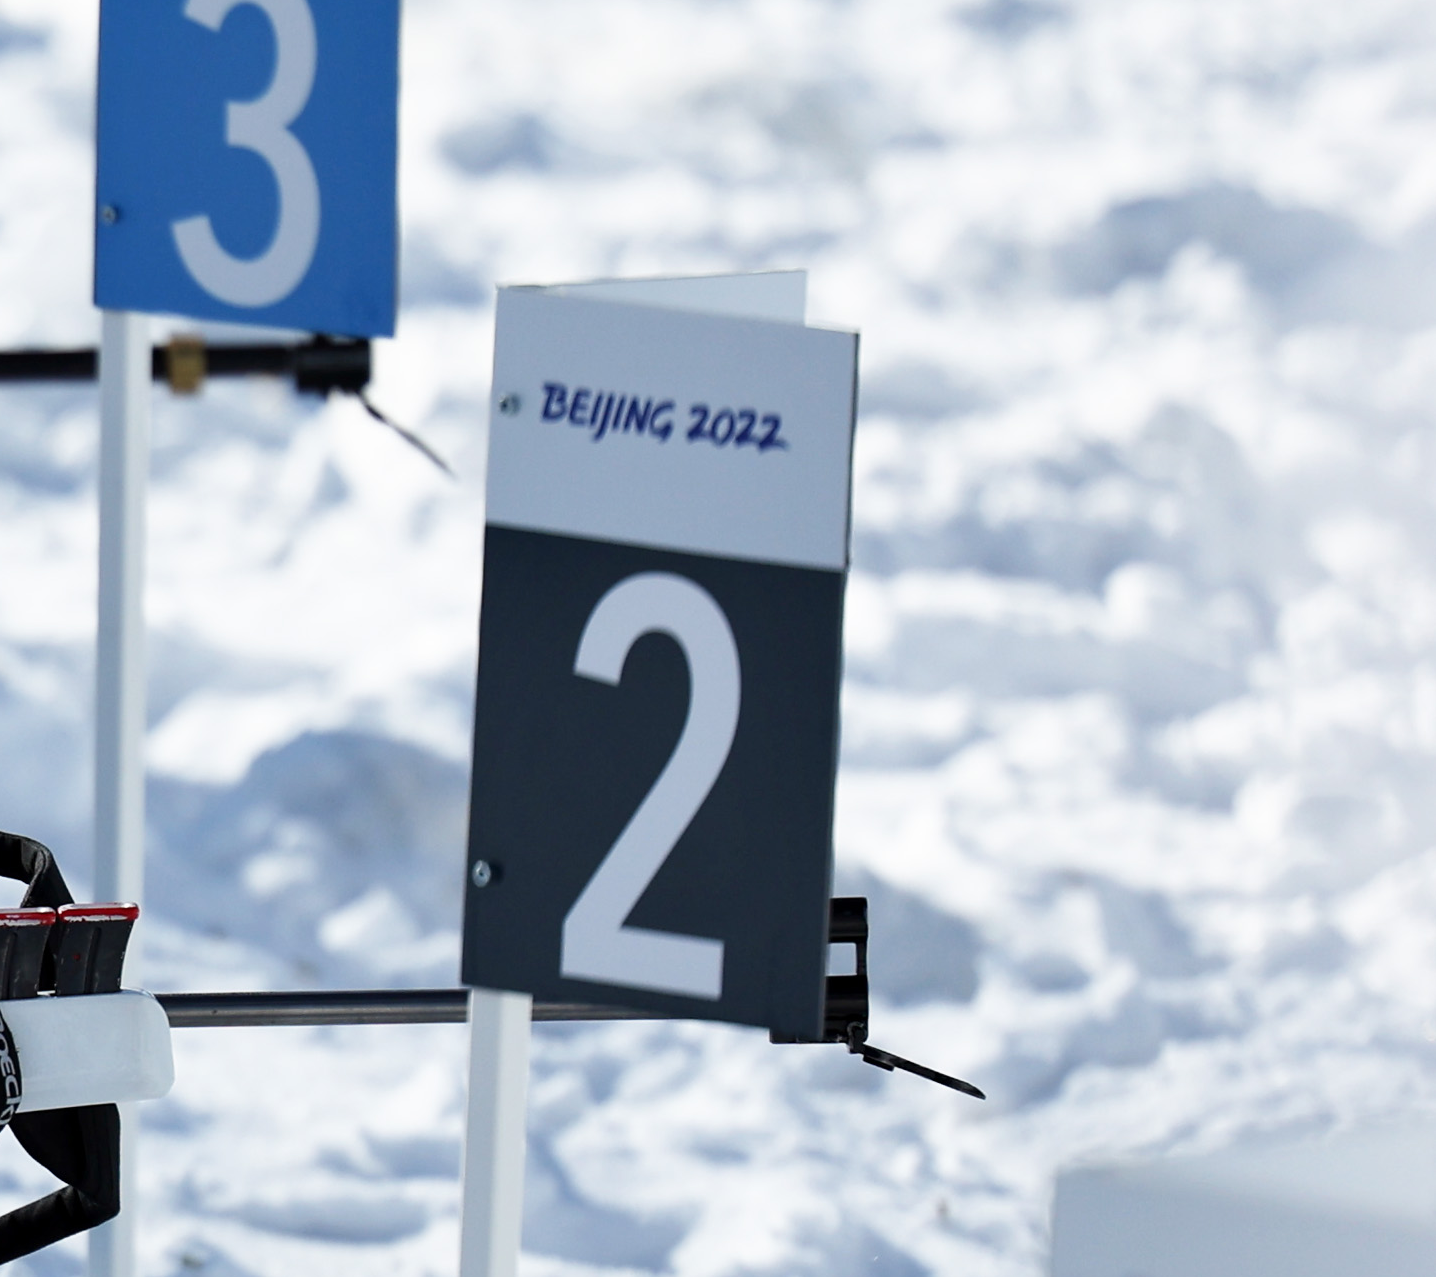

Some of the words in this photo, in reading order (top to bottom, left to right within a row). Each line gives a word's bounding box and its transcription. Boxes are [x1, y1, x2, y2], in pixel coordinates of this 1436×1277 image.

[541, 381, 677, 443] BEIJING
[686, 402, 791, 452] 2022
[560, 570, 742, 1001] 2
